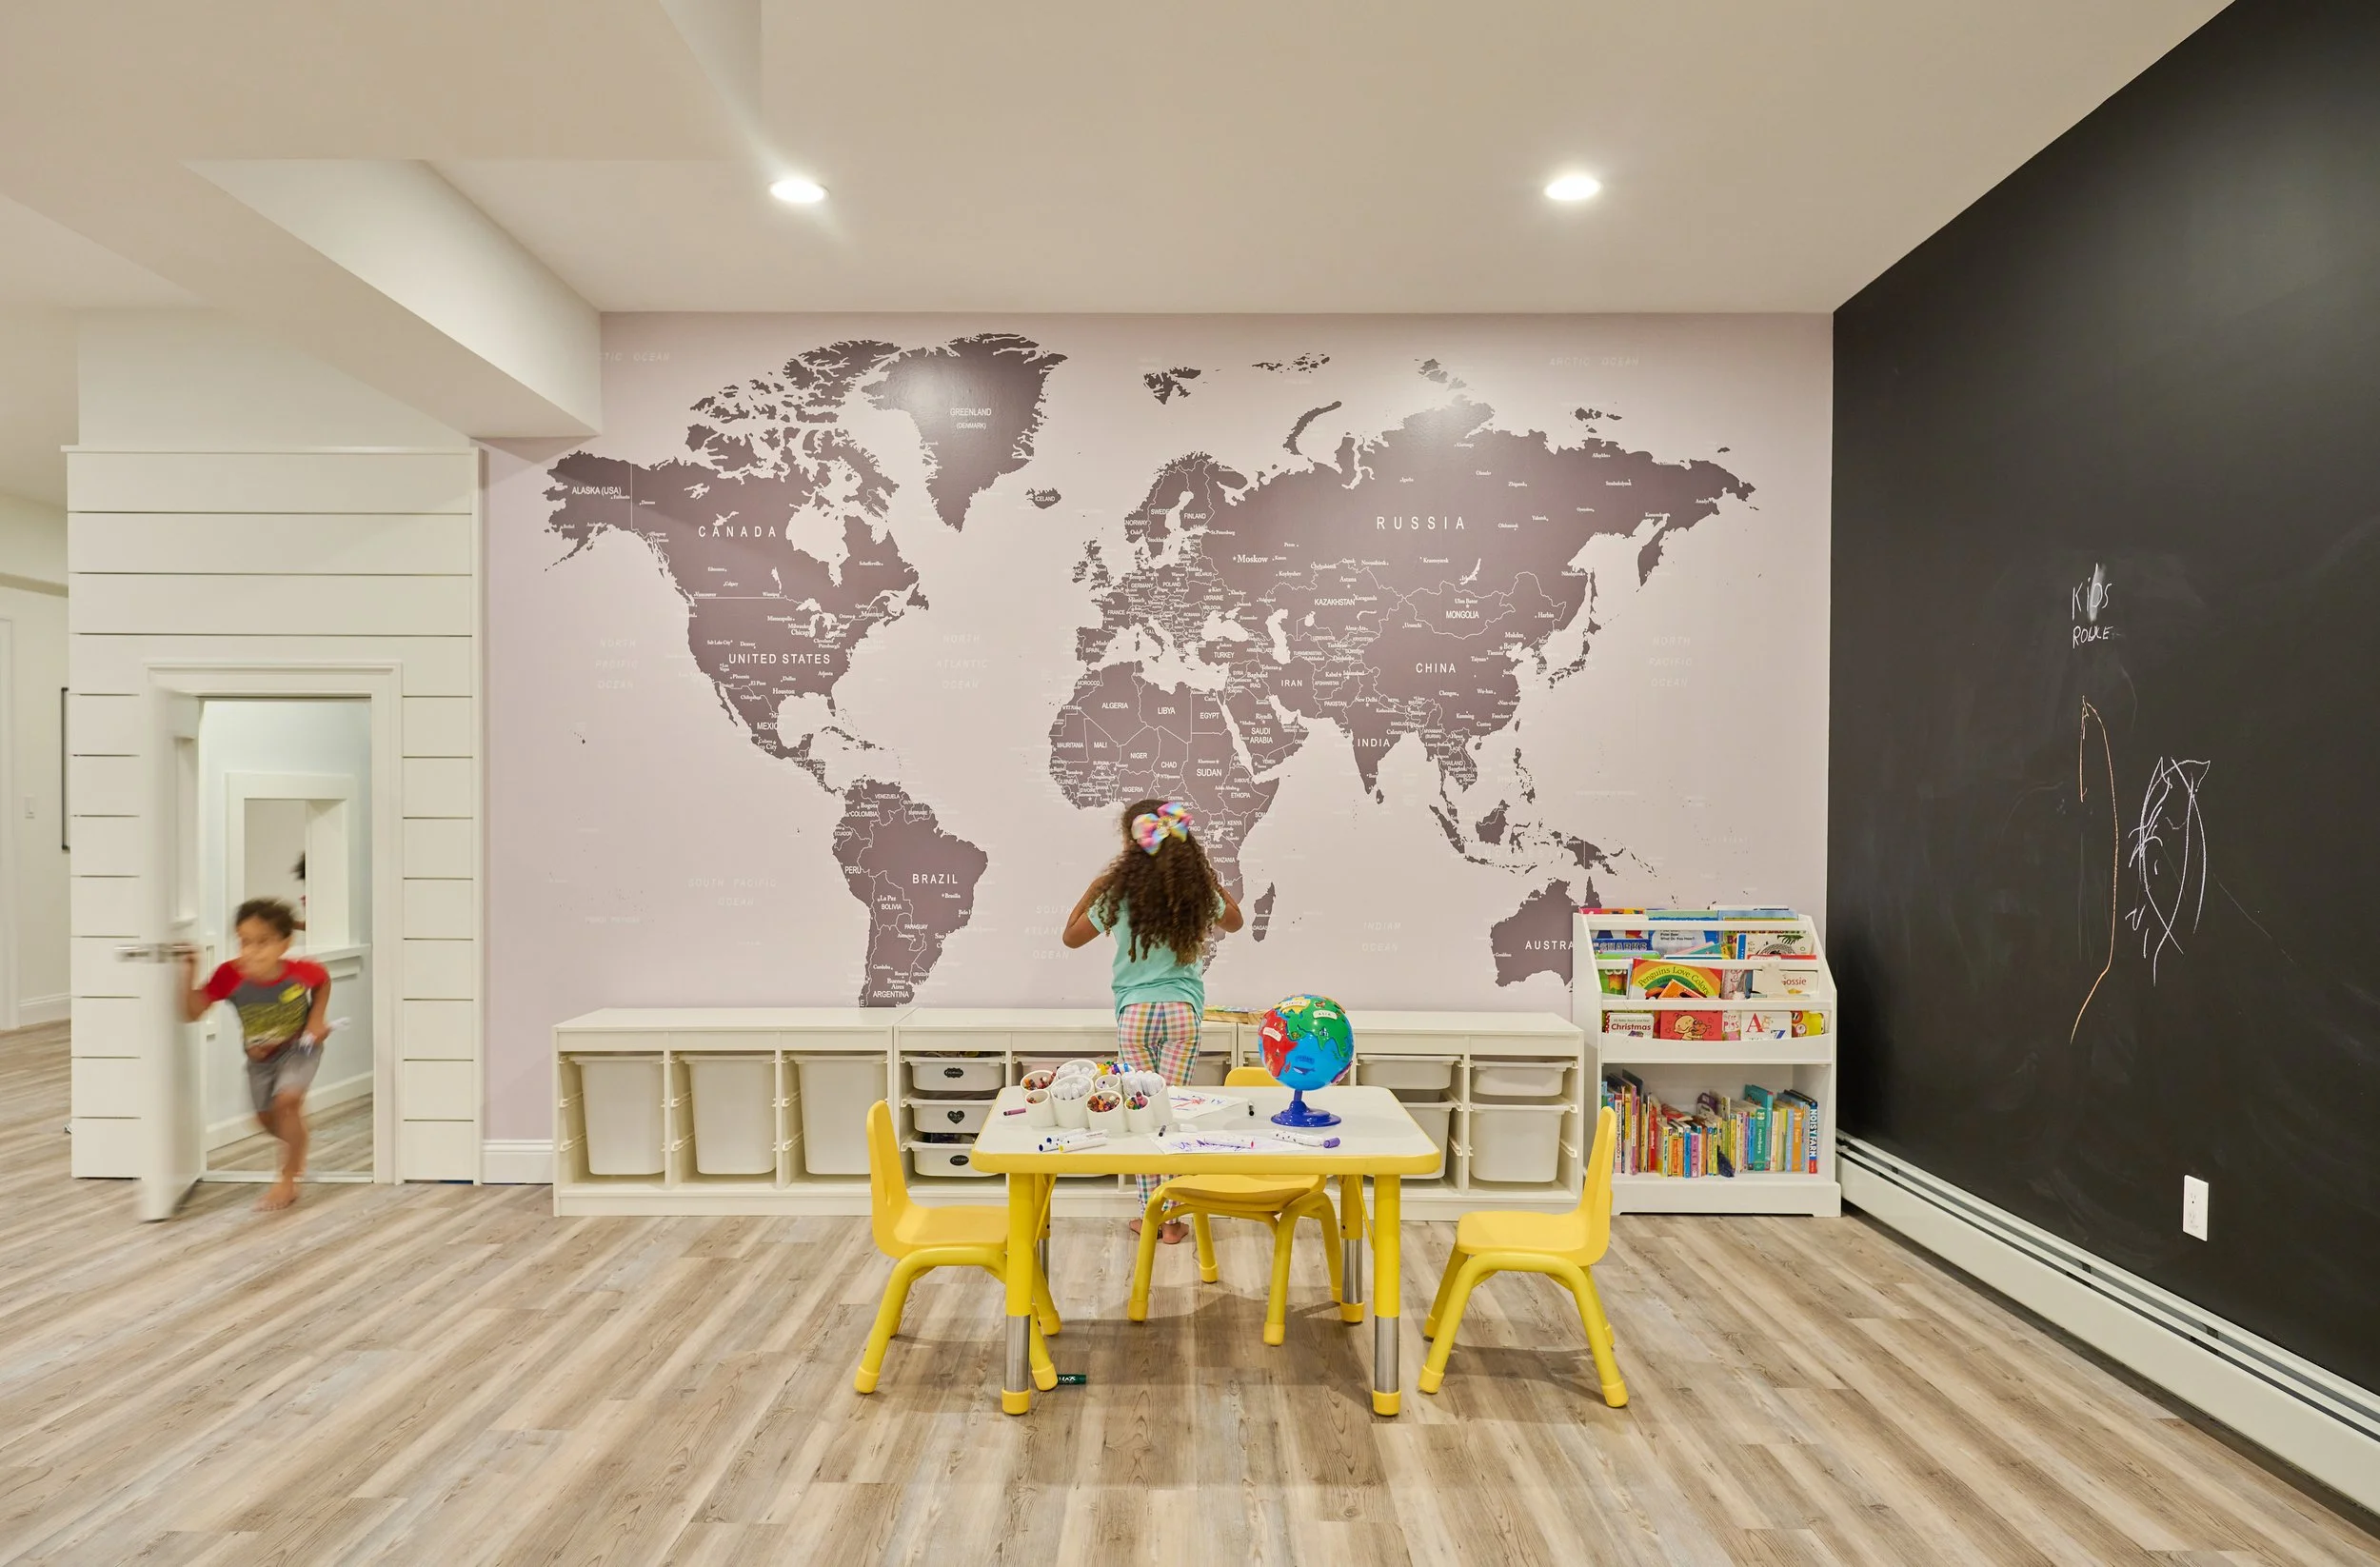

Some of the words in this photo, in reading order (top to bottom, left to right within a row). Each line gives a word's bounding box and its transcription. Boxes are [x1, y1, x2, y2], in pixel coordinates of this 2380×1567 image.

[1601, 357, 1639, 367] OCEAN
[950, 407, 992, 416] GREENLAND
[571, 486, 601, 495] ALASKA
[602, 486, 622, 496] (USA)
[1377, 516, 1465, 530] RUSSIA
[698, 526, 777, 538] CANADA
[1238, 554, 1269, 565] Moskow
[1314, 598, 1356, 606] KAZAKHSTAN
[1445, 610, 1479, 619] MONGOLIA
[728, 653, 777, 664] UNITED
[782, 653, 831, 664] STATES
[1415, 663, 1457, 674] CHINA
[1280, 679, 1303, 687] IRAN
[1157, 706, 1177, 715] LIBYA
[1249, 736, 1274, 744] ARABIA
[1357, 738, 1391, 748] INDIA
[1160, 761, 1178, 769] CHAD
[1196, 768, 1222, 777] SUDAN
[1121, 785, 1144, 794] NIGERIA
[844, 865, 862, 875] PERU
[912, 873, 959, 884] BRAZIL
[1637, 967, 1672, 987] Penguins
[1673, 966, 1692, 977] Love
[1691, 974, 1711, 994] Colors
[872, 990, 910, 999] ARGENTINA
[1611, 1022, 1652, 1031] Christmas
[1809, 1108, 1817, 1135] NOISY
[1809, 1136, 1817, 1158] FARM
